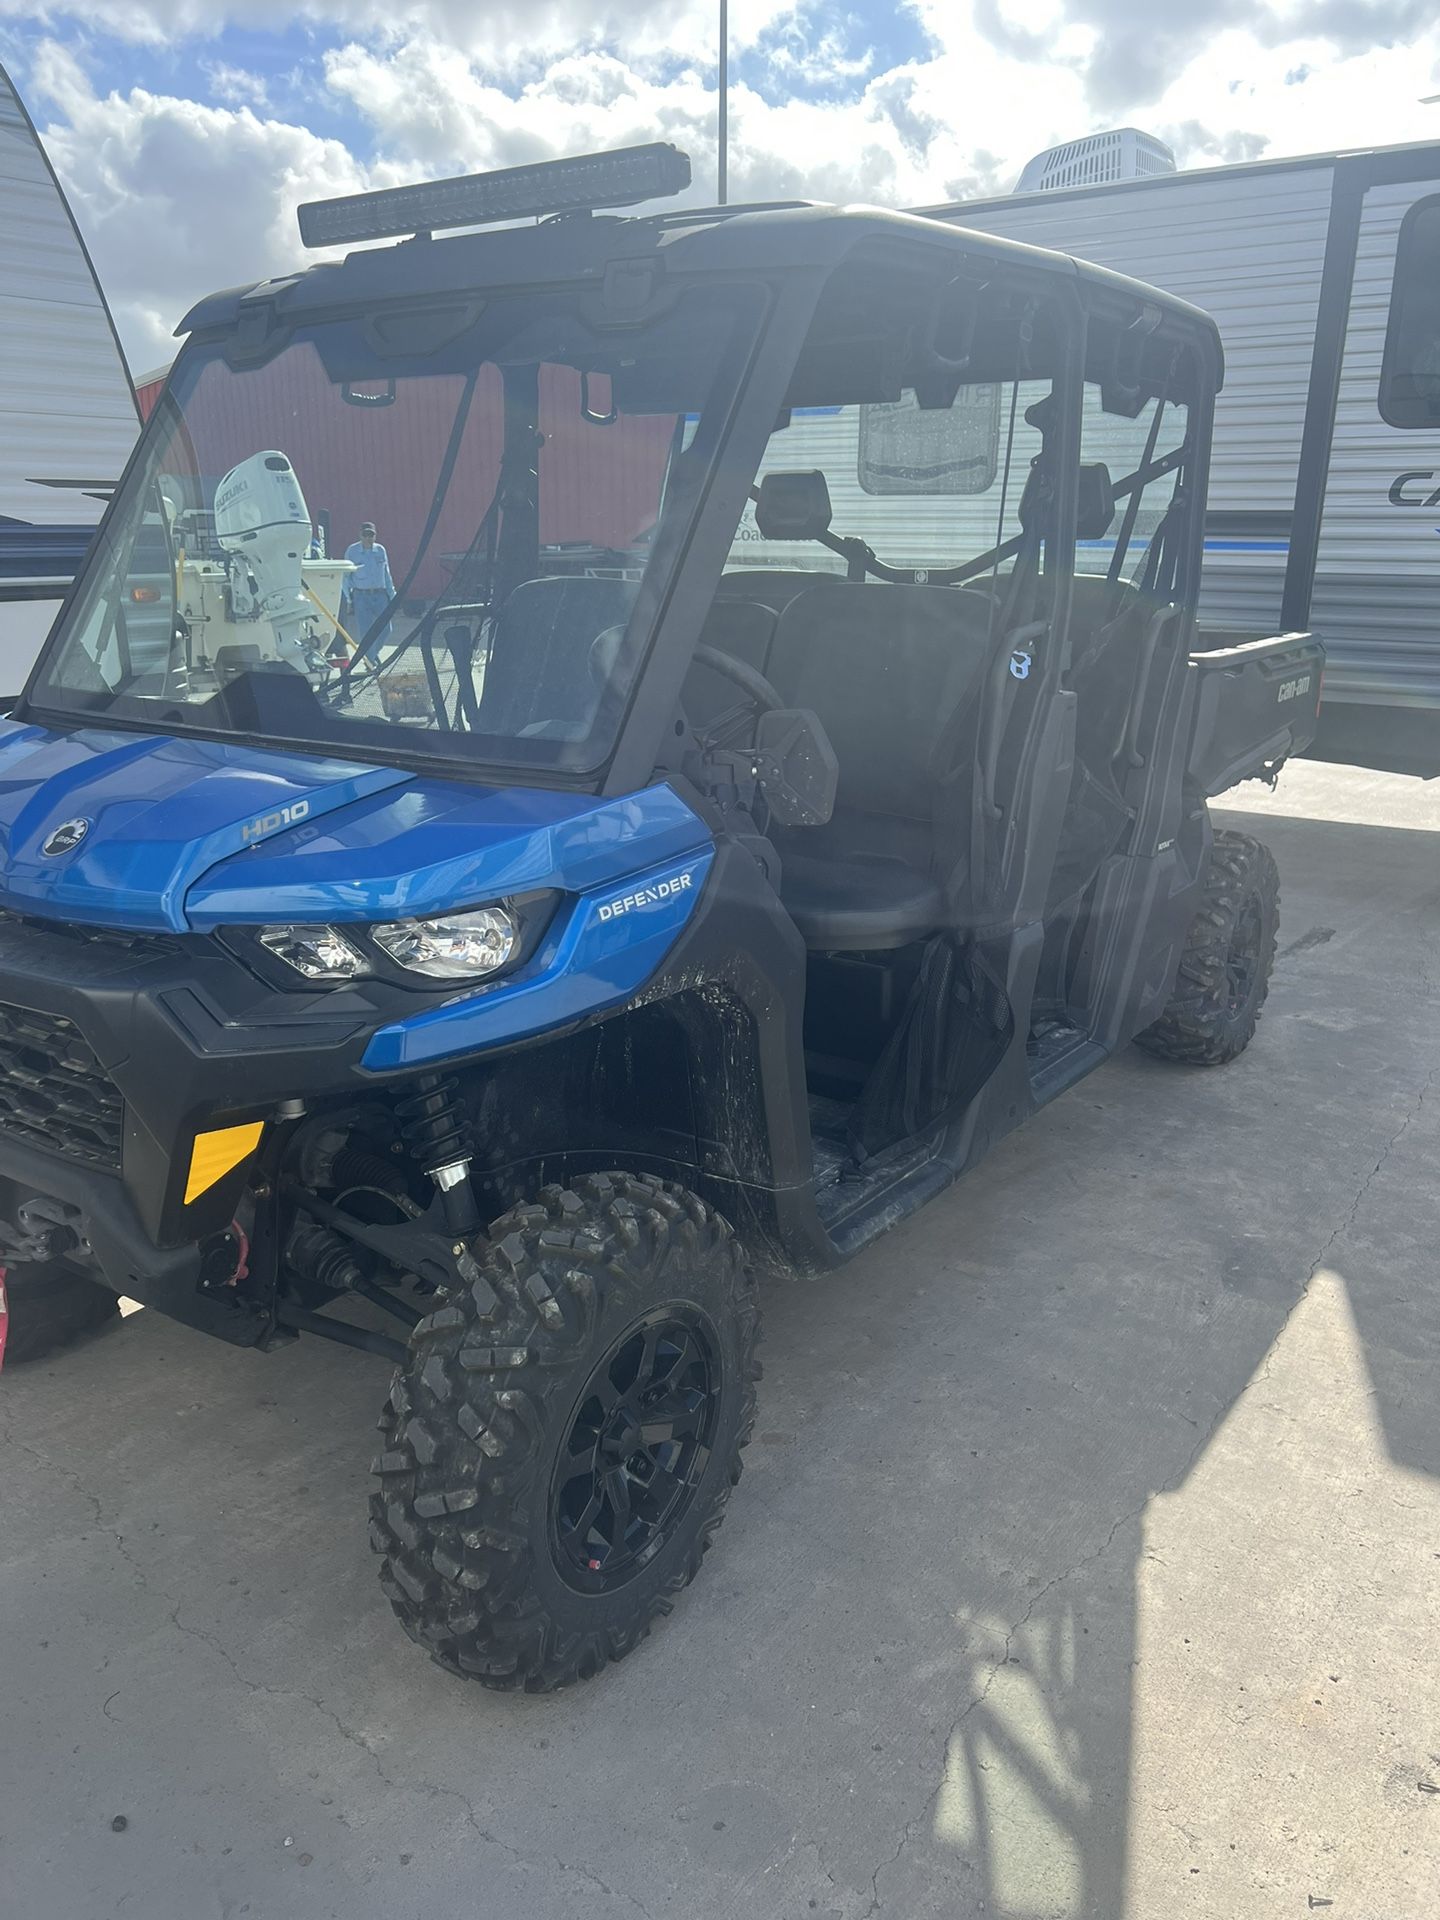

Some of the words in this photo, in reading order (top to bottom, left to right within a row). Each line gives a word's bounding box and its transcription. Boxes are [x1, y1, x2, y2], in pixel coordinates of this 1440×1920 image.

[216, 480, 249, 511] SUZUKI
[242, 799, 309, 842] HD10
[55, 835, 77, 845] BRP
[598, 873, 692, 921] DEFENDER
